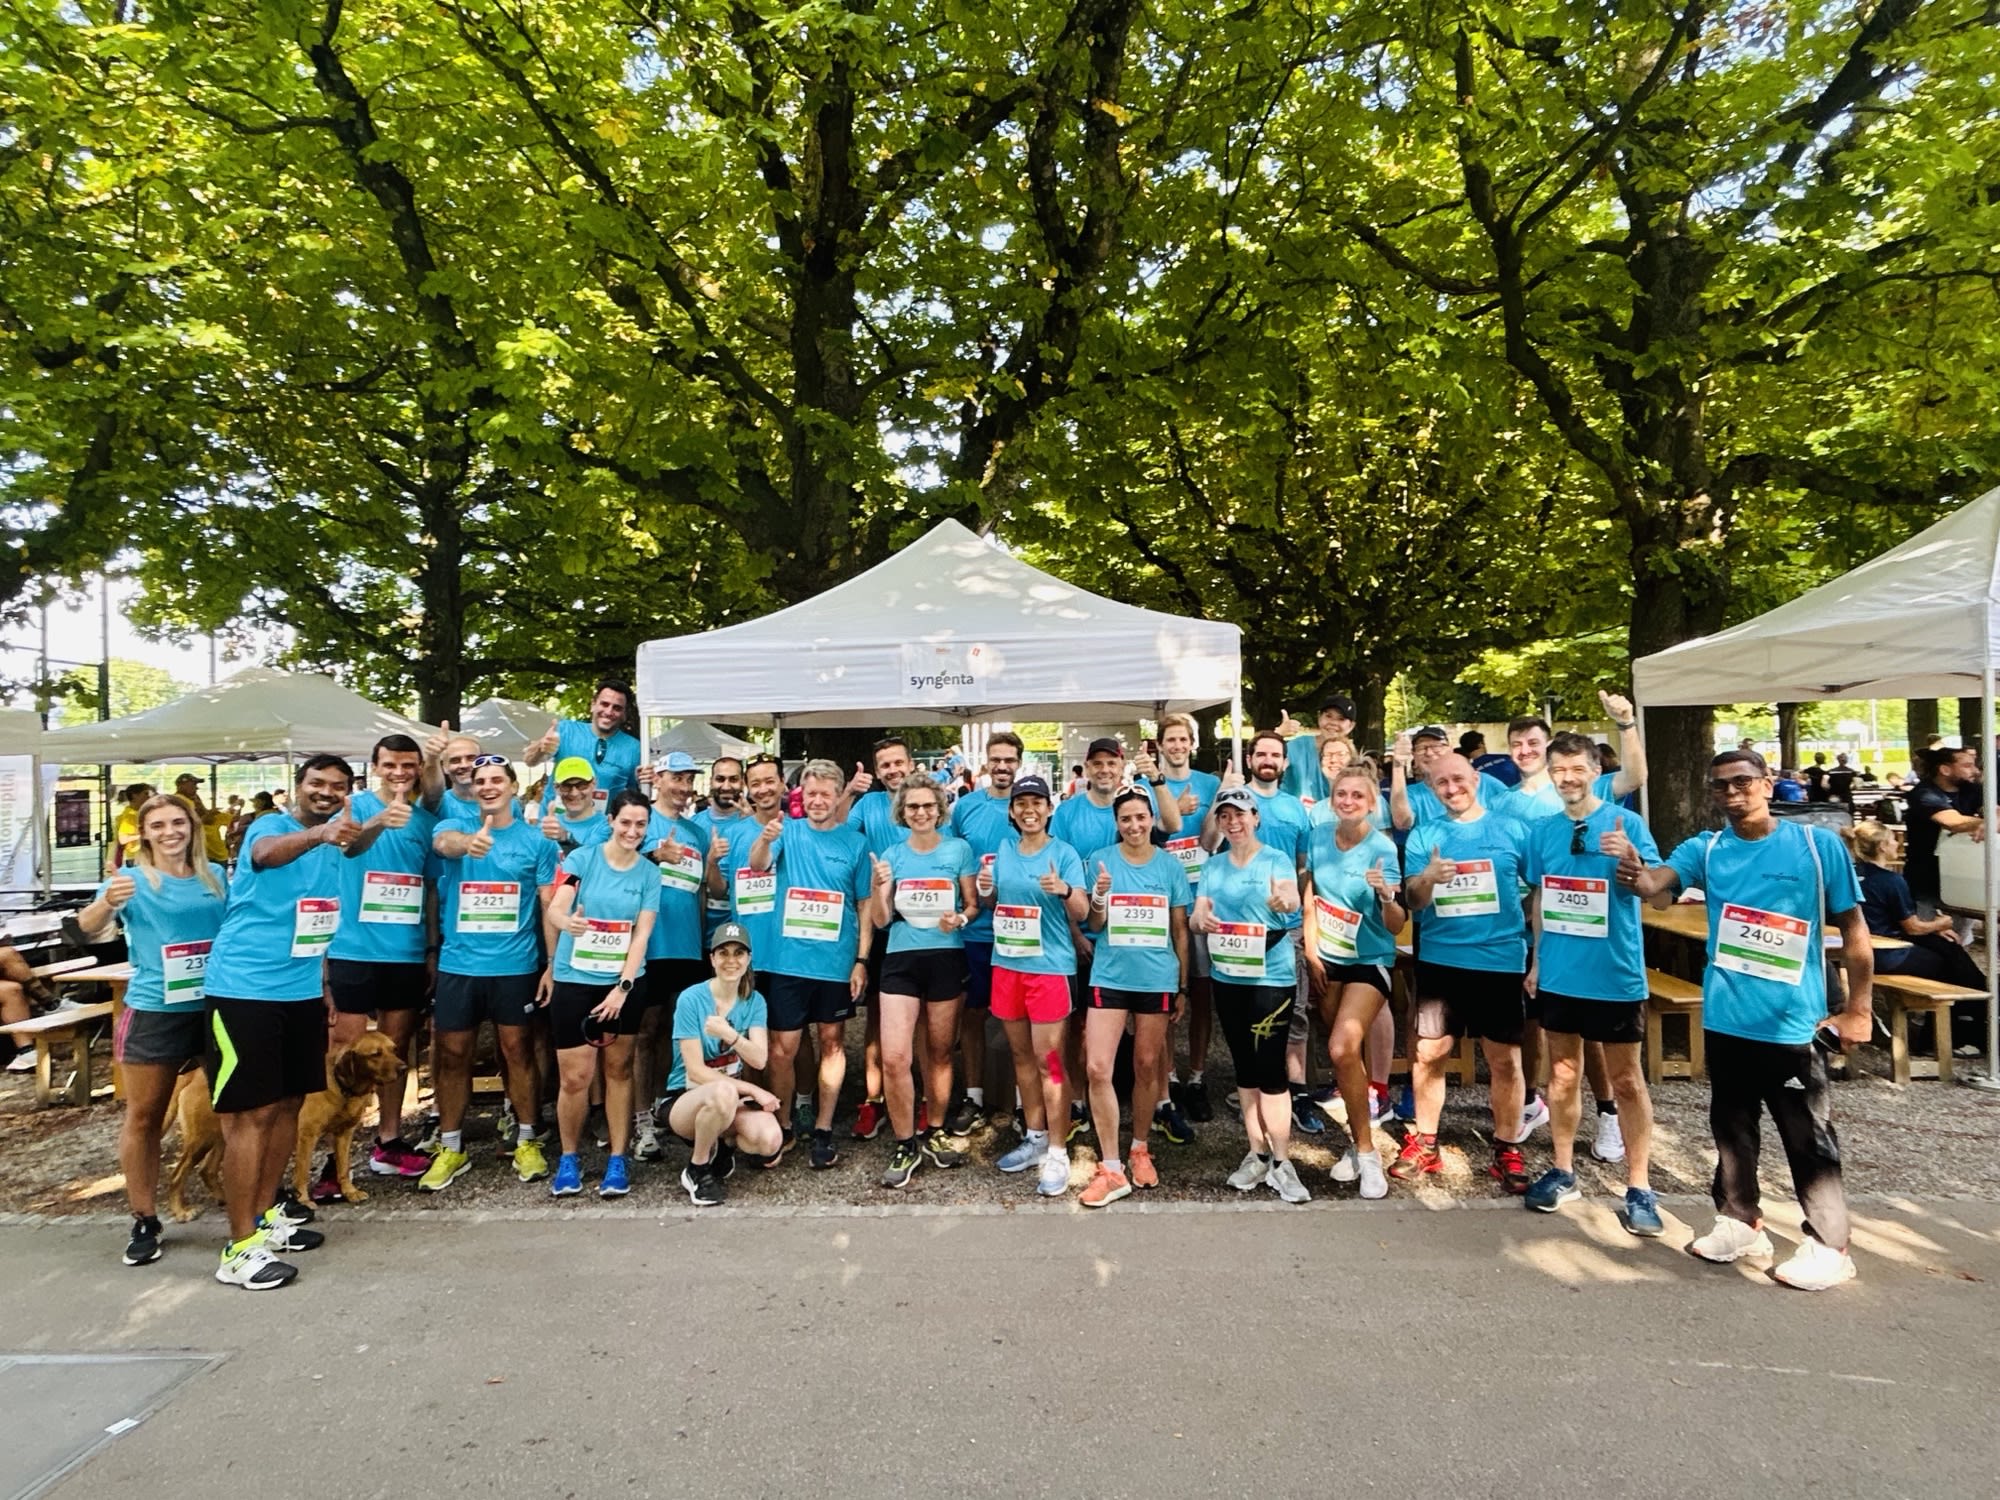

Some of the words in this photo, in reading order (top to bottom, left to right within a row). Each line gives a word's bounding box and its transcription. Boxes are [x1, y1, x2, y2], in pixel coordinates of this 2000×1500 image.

[910, 672, 975, 690] syngenta
[746, 878, 773, 890] 2402
[380, 886, 410, 897] 2417
[911, 892, 939, 902] 4761
[473, 896, 504, 906] 2421
[1558, 892, 1589, 906] 2403
[800, 902, 829, 914] 2419
[1124, 908, 1154, 919] 2393
[1003, 919, 1026, 931] 2413
[592, 933, 622, 946] 2406
[1740, 925, 1785, 946] 2405
[1220, 936, 1248, 948] 2401
